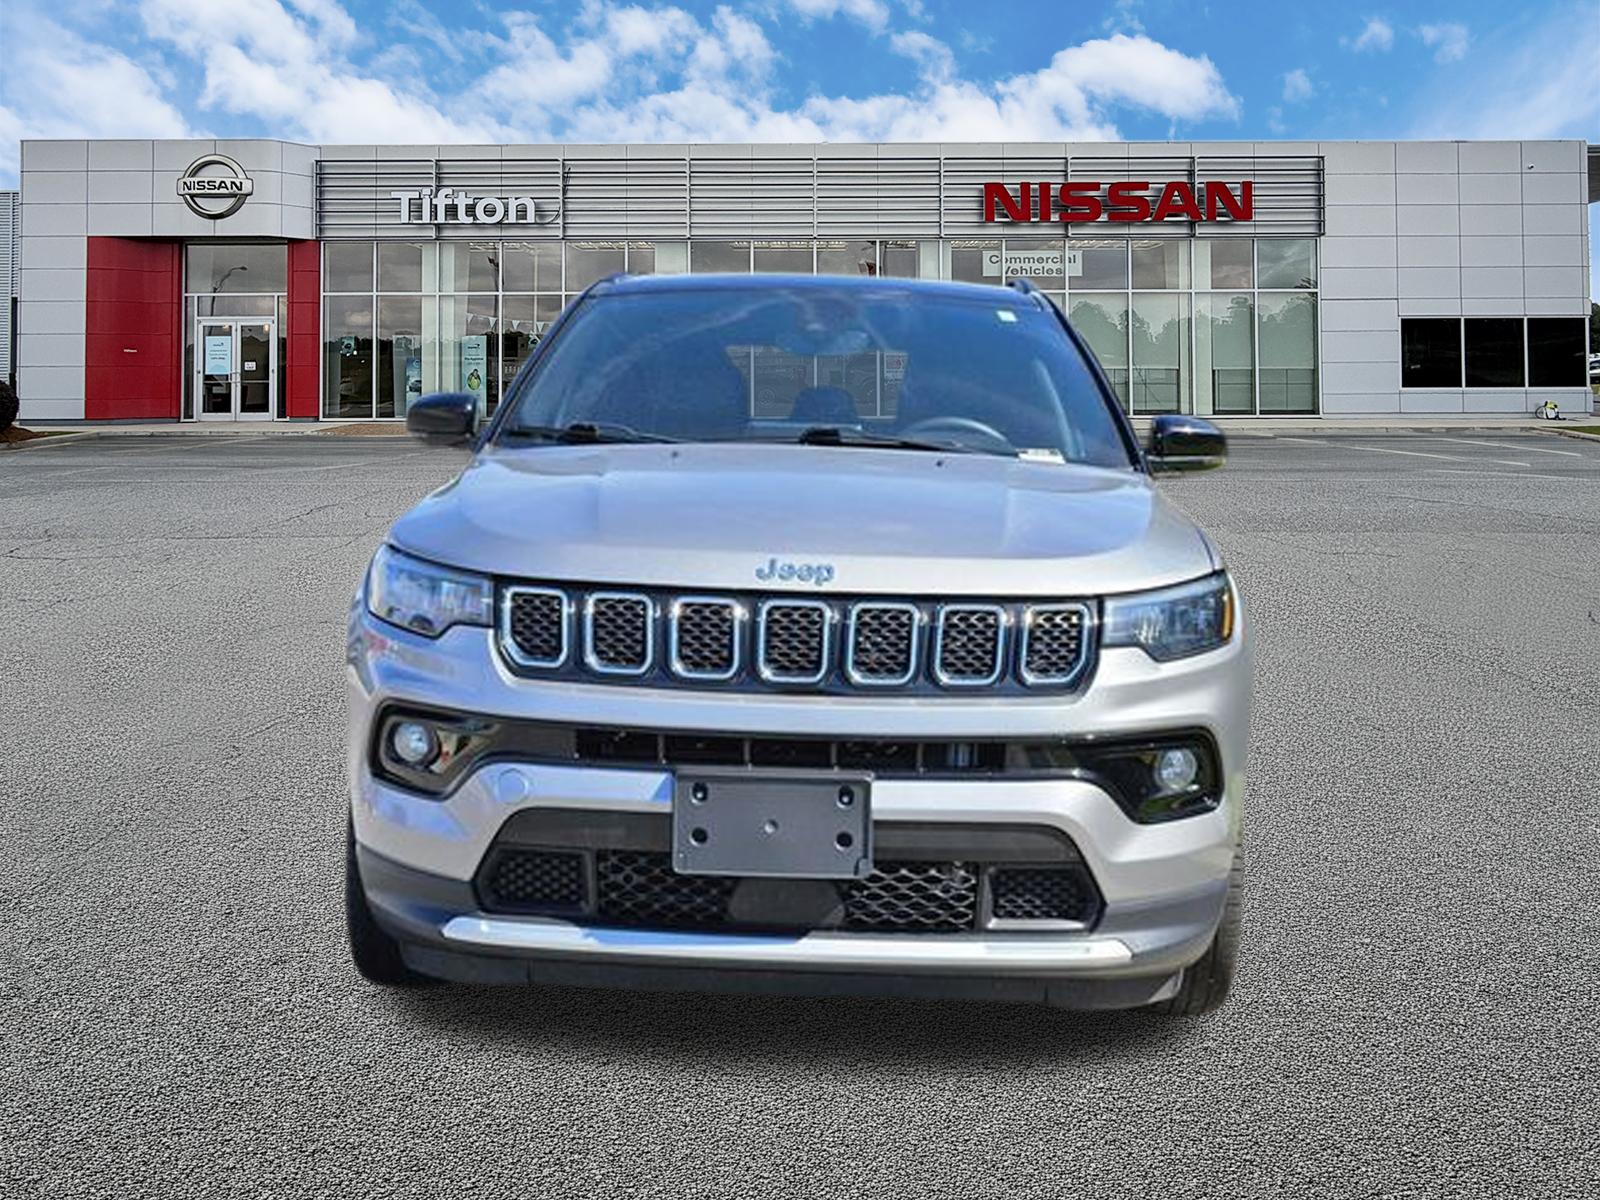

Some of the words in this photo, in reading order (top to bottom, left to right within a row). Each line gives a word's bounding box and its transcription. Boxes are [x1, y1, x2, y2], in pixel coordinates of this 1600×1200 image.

[182, 180, 243, 191] NISSAN
[984, 181, 1253, 221] NISSAN
[391, 188, 536, 224] Tifton
[755, 558, 835, 586] Jeep
